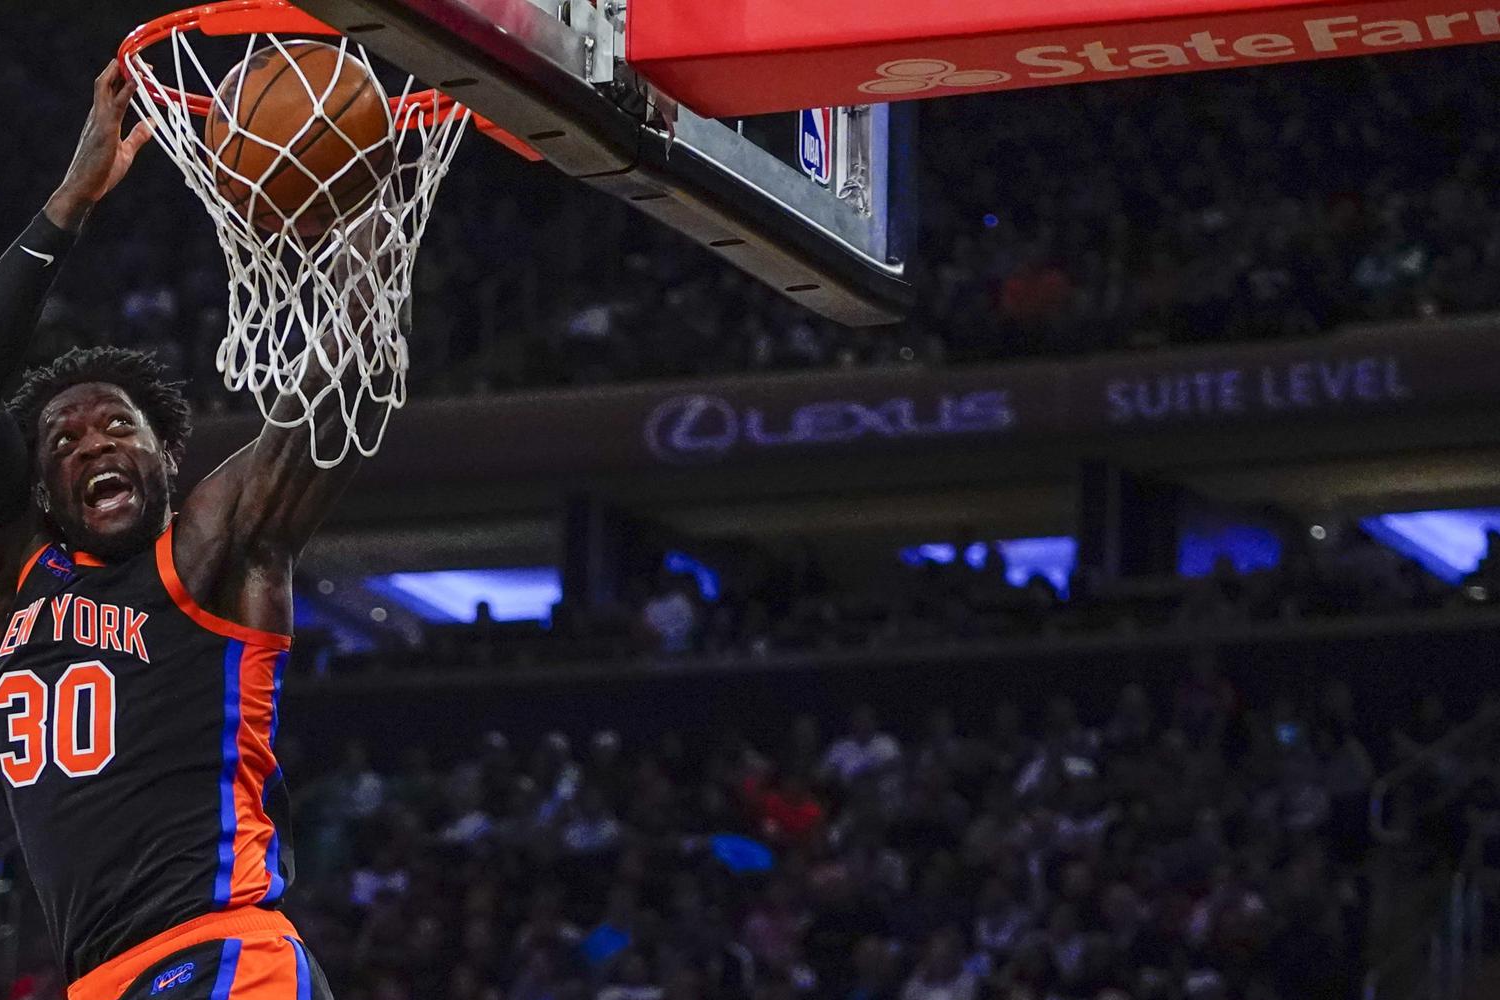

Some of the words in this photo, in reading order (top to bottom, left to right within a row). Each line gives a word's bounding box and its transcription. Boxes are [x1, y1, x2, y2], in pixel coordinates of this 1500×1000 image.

[1015, 30, 1296, 79] State
[804, 131, 820, 167] NBA
[745, 389, 1017, 445] LEXUS
[1106, 369, 1242, 423] SUITE
[1262, 356, 1413, 410] LEVEL
[51, 593, 150, 664] YORK
